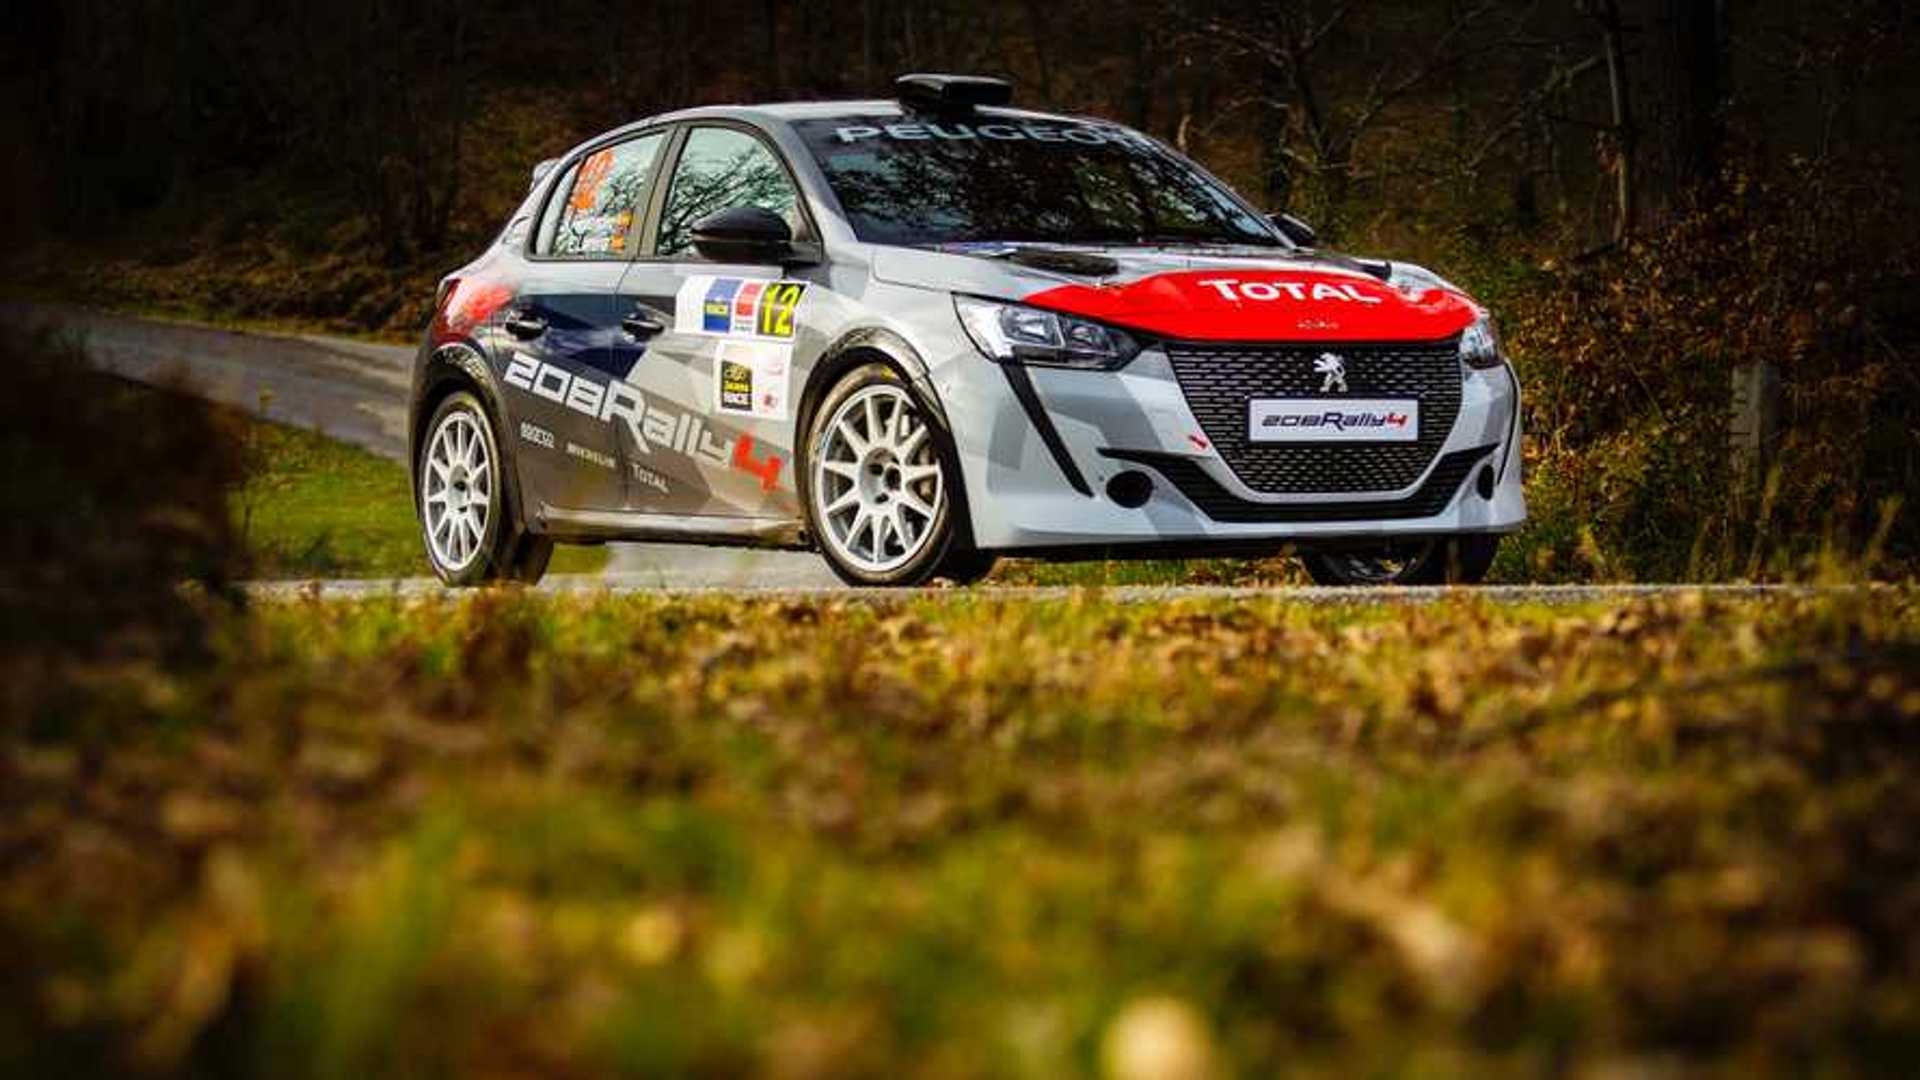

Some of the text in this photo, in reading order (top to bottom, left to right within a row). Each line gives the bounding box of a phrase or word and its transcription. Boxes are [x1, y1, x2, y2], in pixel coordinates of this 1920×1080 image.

[1198, 279, 1382, 304] TOTAL
[763, 283, 799, 334] 12
[632, 463, 669, 493] TOTAL
